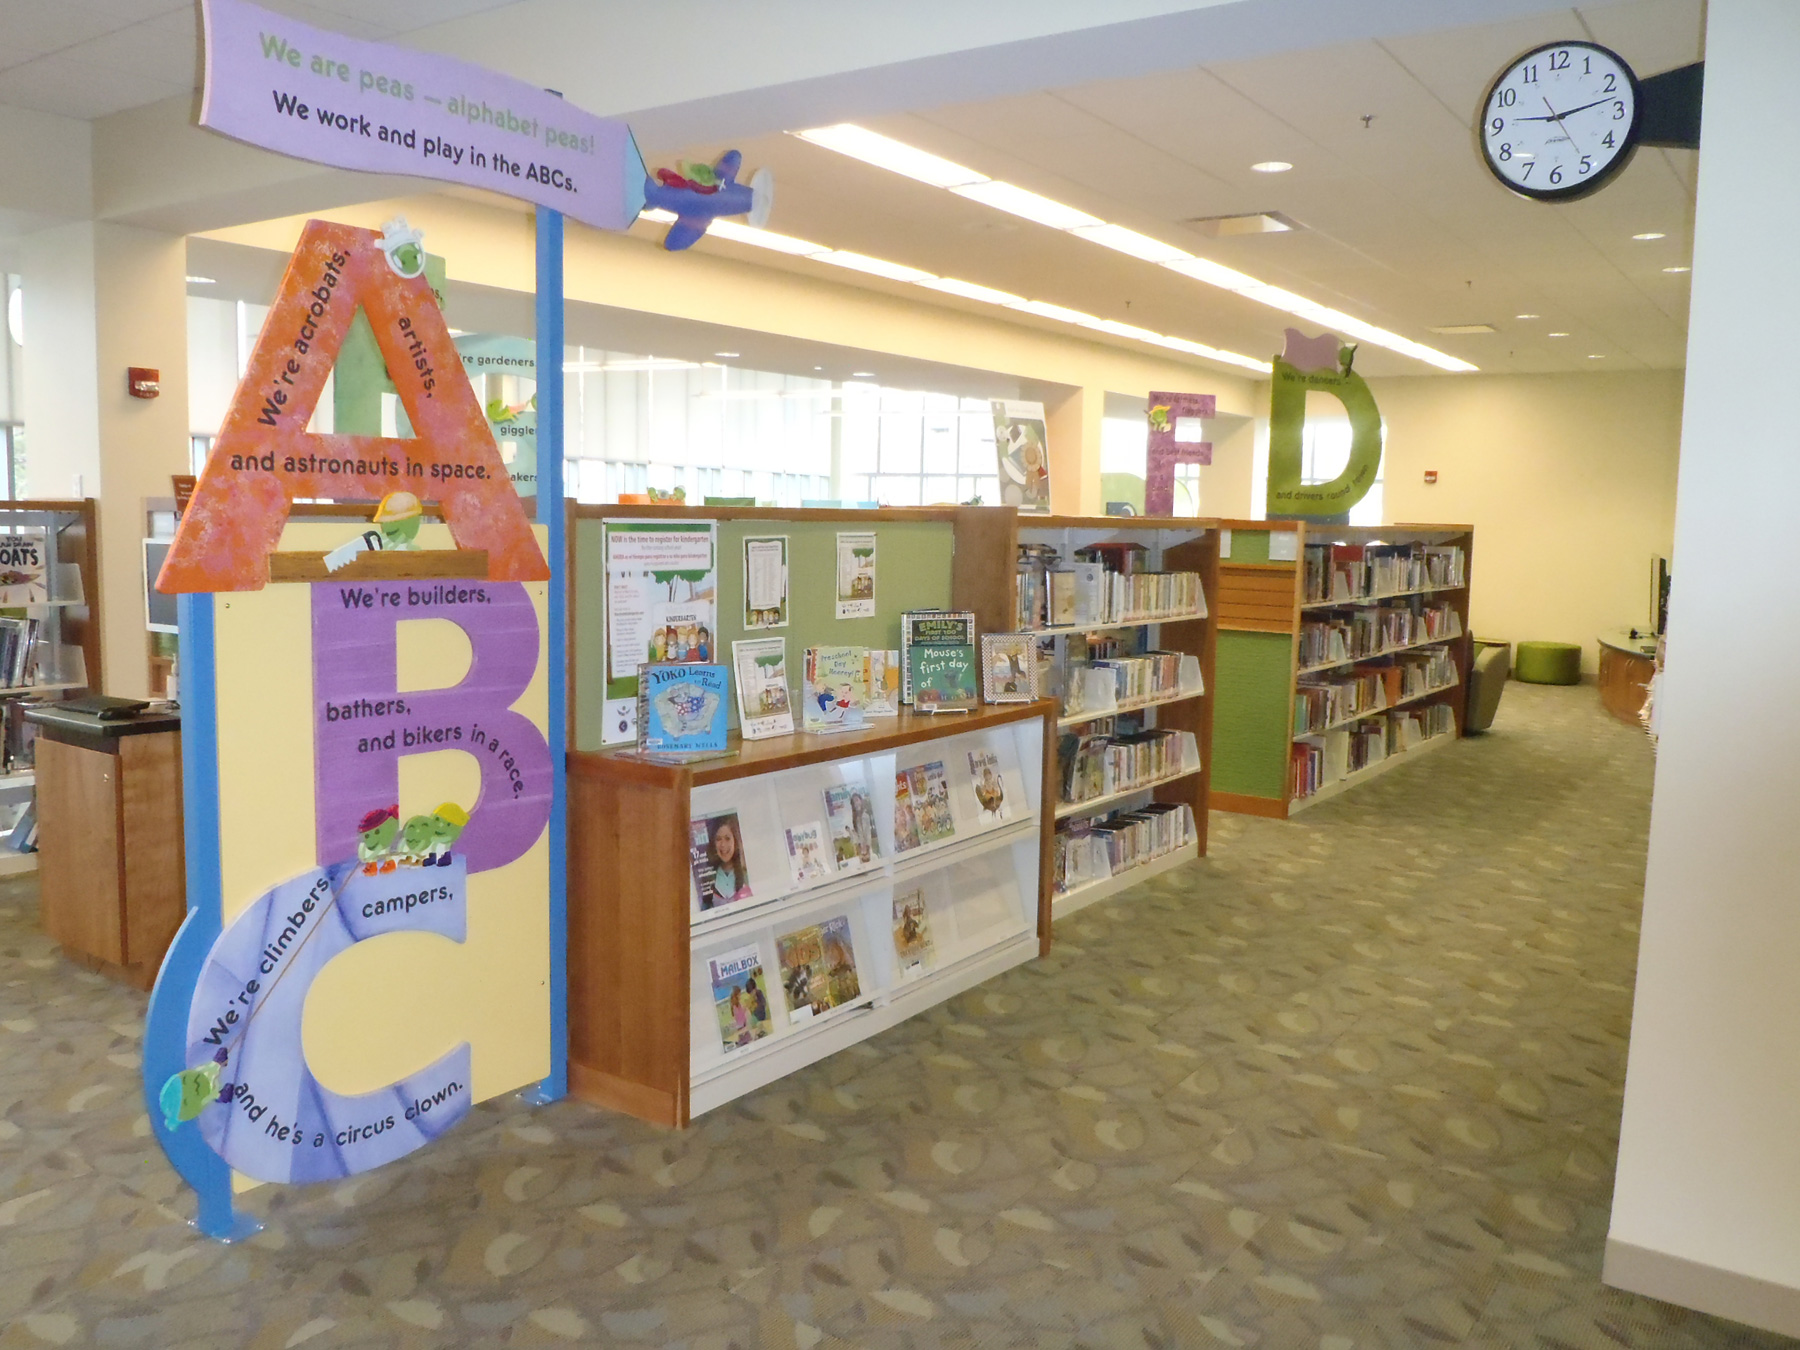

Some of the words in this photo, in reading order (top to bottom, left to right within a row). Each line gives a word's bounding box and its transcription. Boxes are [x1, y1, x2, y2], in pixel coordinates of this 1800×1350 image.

[1549, 50, 1571, 71] 12
[1583, 56, 1591, 75] 1
[1522, 64, 1538, 84] 11
[1603, 73, 1617, 93] 2
[259, 31, 301, 67] We
[310, 54, 350, 82] are
[359, 69, 415, 101] peas
[448, 94, 539, 138] alphabet
[545, 126, 595, 155] peas!
[1497, 88, 1516, 108] 10
[1612, 101, 1625, 120] 3
[1491, 118, 1504, 137] 9
[272, 90, 309, 120] We
[316, 107, 371, 137] work
[378, 125, 416, 150] and
[424, 136, 464, 165] play
[470, 146, 486, 168] in
[492, 153, 520, 177] the
[526, 163, 578, 193] ABCs.
[1601, 130, 1615, 149] 4
[1499, 142, 1512, 161] 8
[1522, 162, 1535, 181] 7
[1578, 155, 1591, 174] 5
[1550, 165, 1563, 184] 6
[257, 360, 300, 427] We're
[294, 250, 351, 355] acrobats,
[398, 317, 435, 399] artists,
[500, 424, 536, 436] giggle
[231, 451, 275, 472] and
[284, 453, 399, 477] astronauts
[406, 457, 423, 477] in
[431, 462, 491, 483] space.
[1276, 490, 1292, 500] and
[1295, 491, 1323, 501] drivers
[0, 548, 38, 567] OATS
[340, 588, 400, 609] We're
[408, 585, 492, 607] builders,
[919, 620, 964, 632] EMILY'S
[924, 648, 964, 659] Mouse's
[652, 668, 686, 684] YOKO
[689, 667, 716, 679] Learns
[920, 661, 945, 674] first
[949, 658, 969, 673] day
[701, 677, 722, 690] Read
[921, 677, 933, 688] of
[326, 698, 411, 722] bathers,
[358, 730, 395, 753] and
[403, 725, 462, 747] bikers
[471, 724, 486, 745] in
[488, 738, 499, 753] a
[498, 751, 524, 799] race.
[362, 885, 453, 918] campers,
[203, 978, 261, 1048] We're
[260, 874, 336, 975] climbers,
[721, 955, 759, 978] MAILBOX
[233, 1082, 268, 1122] and
[265, 1115, 303, 1145] he's
[313, 1133, 324, 1147] a
[336, 1114, 396, 1146] circus
[404, 1081, 463, 1120] clown.
